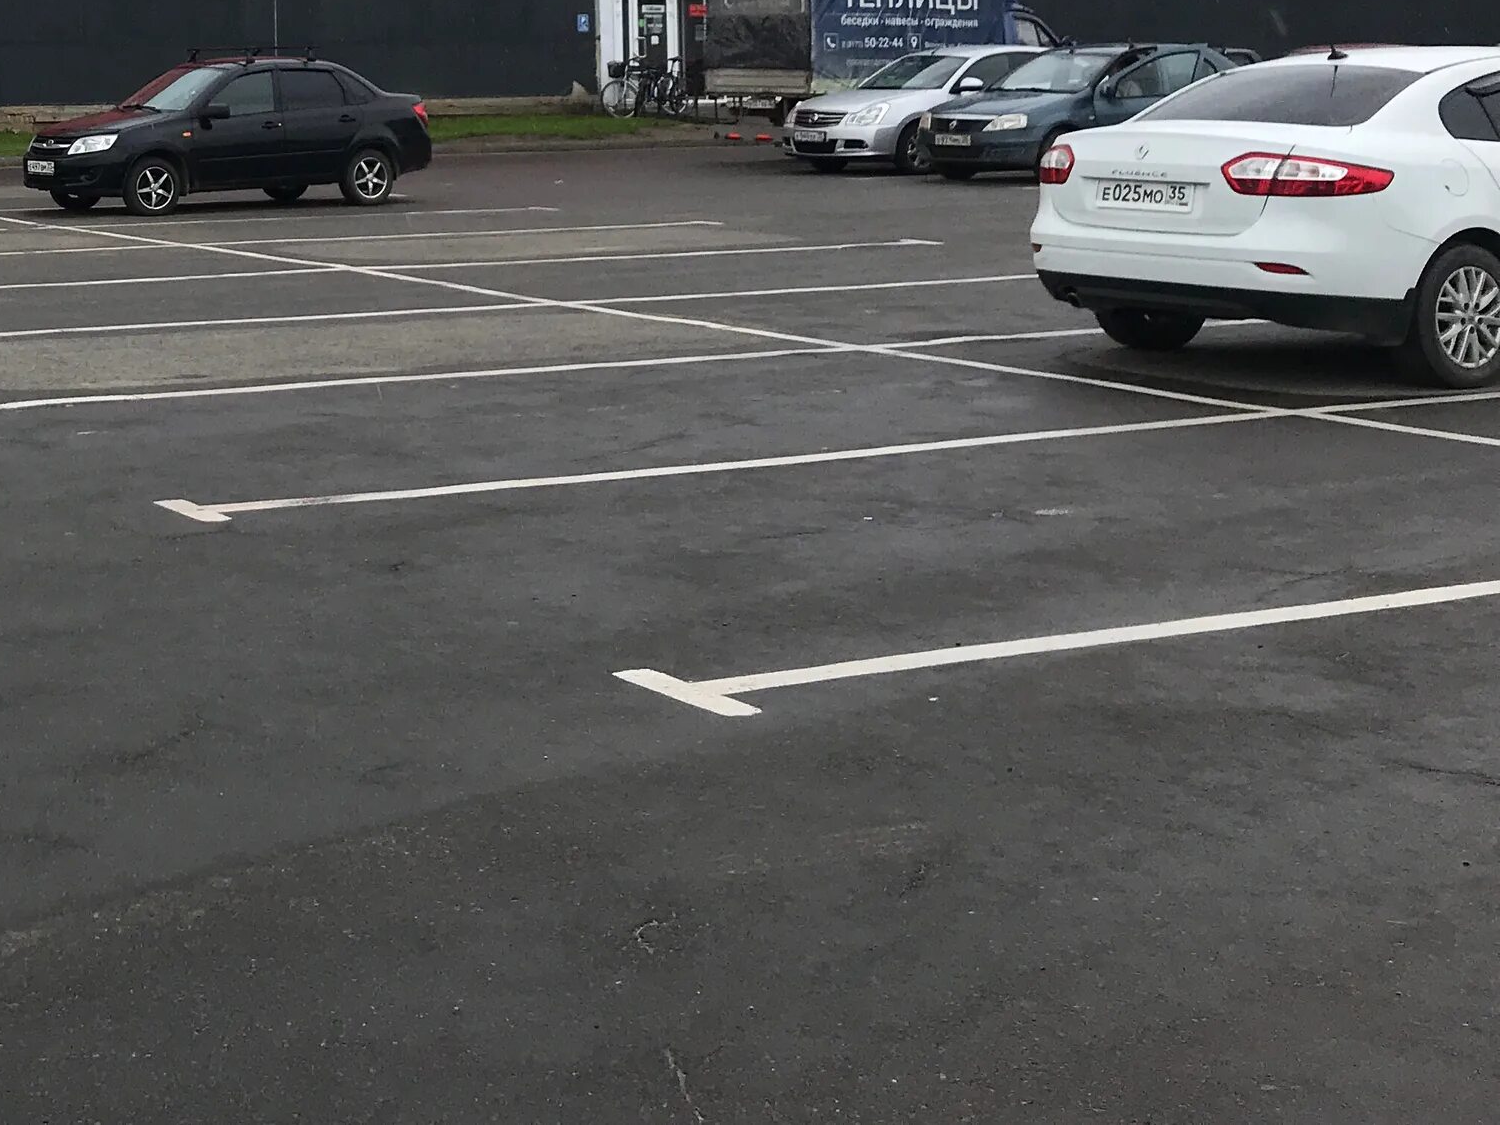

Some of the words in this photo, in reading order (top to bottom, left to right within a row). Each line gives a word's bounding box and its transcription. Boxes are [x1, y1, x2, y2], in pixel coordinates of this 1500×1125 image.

[840, 13, 880, 28] беседки
[864, 37, 904, 49] 50-22-44
[1168, 185, 1186, 201] 35
